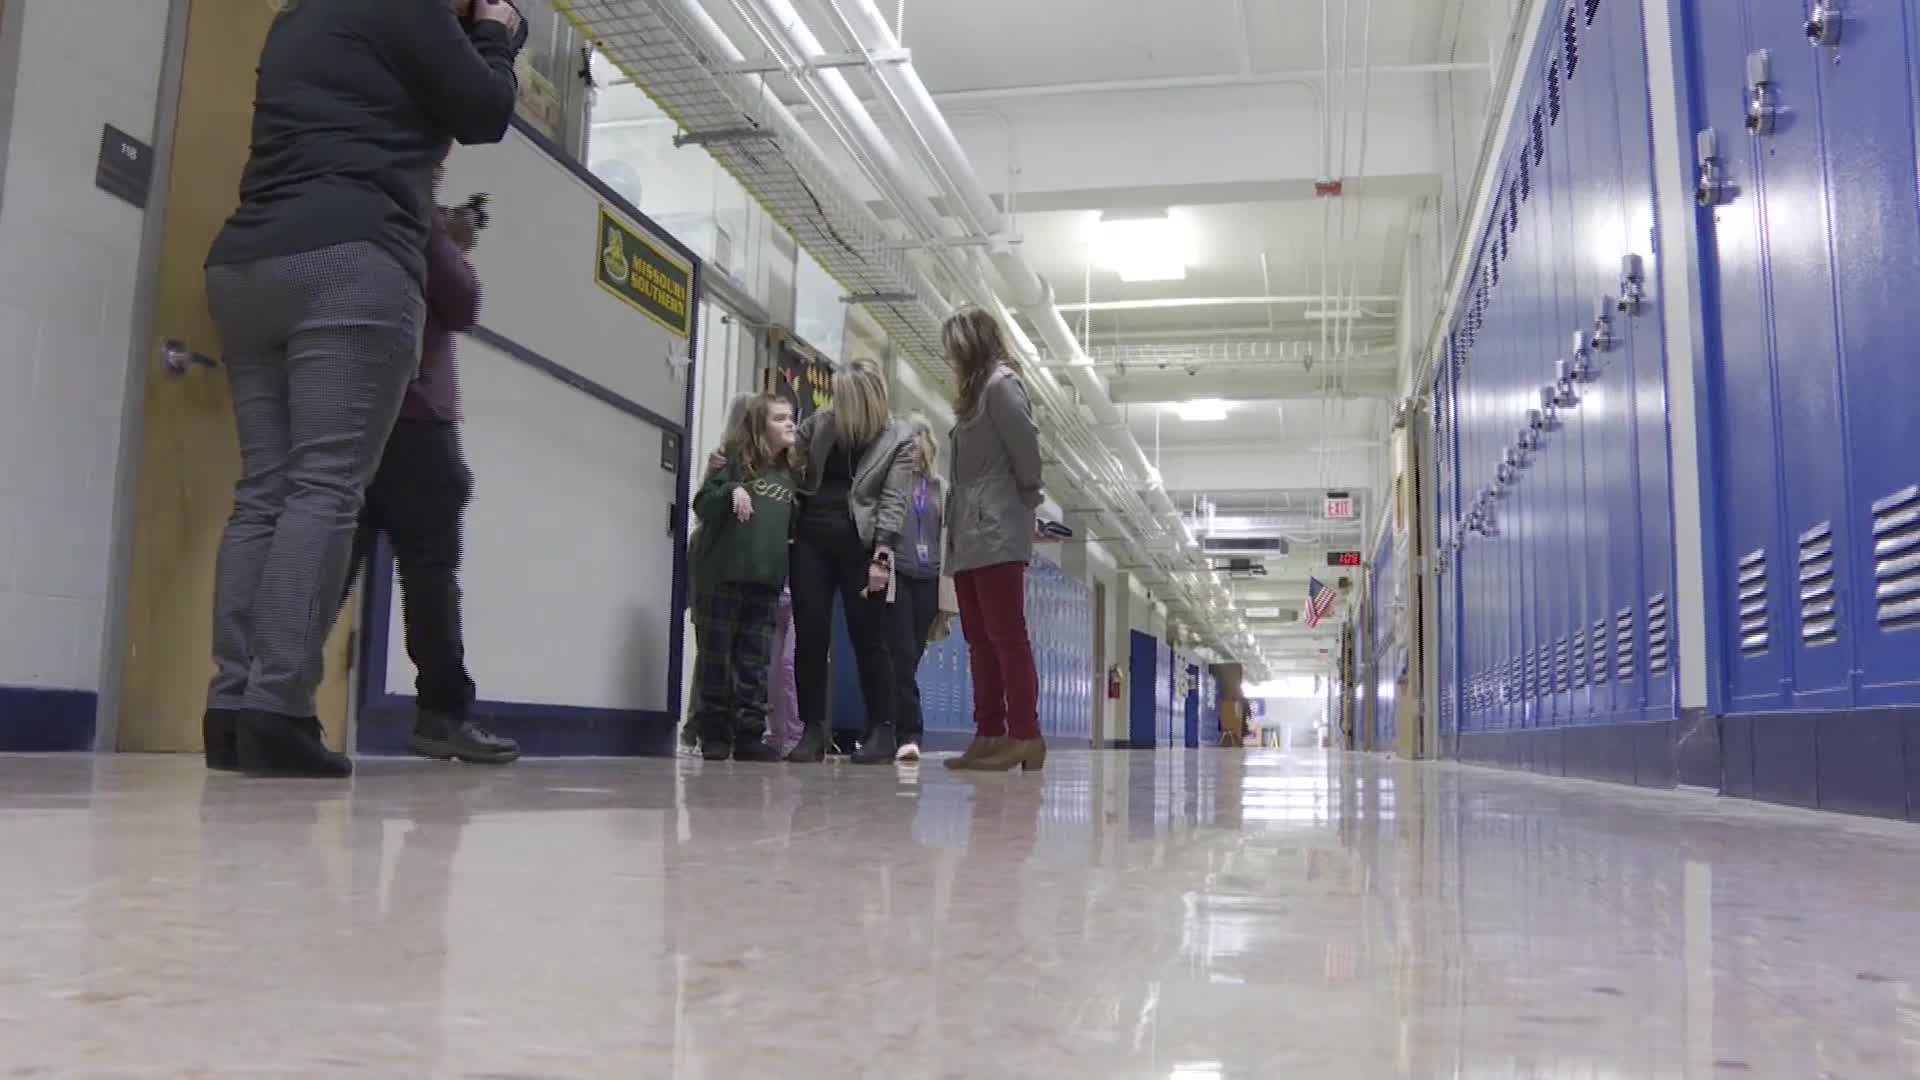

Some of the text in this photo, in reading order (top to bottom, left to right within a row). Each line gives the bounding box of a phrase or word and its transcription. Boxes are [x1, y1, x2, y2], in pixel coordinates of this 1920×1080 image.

[630, 271, 685, 316] SOUTHERN
[631, 255, 686, 301] MISSOURI
[1328, 500, 1349, 516] EXIT
